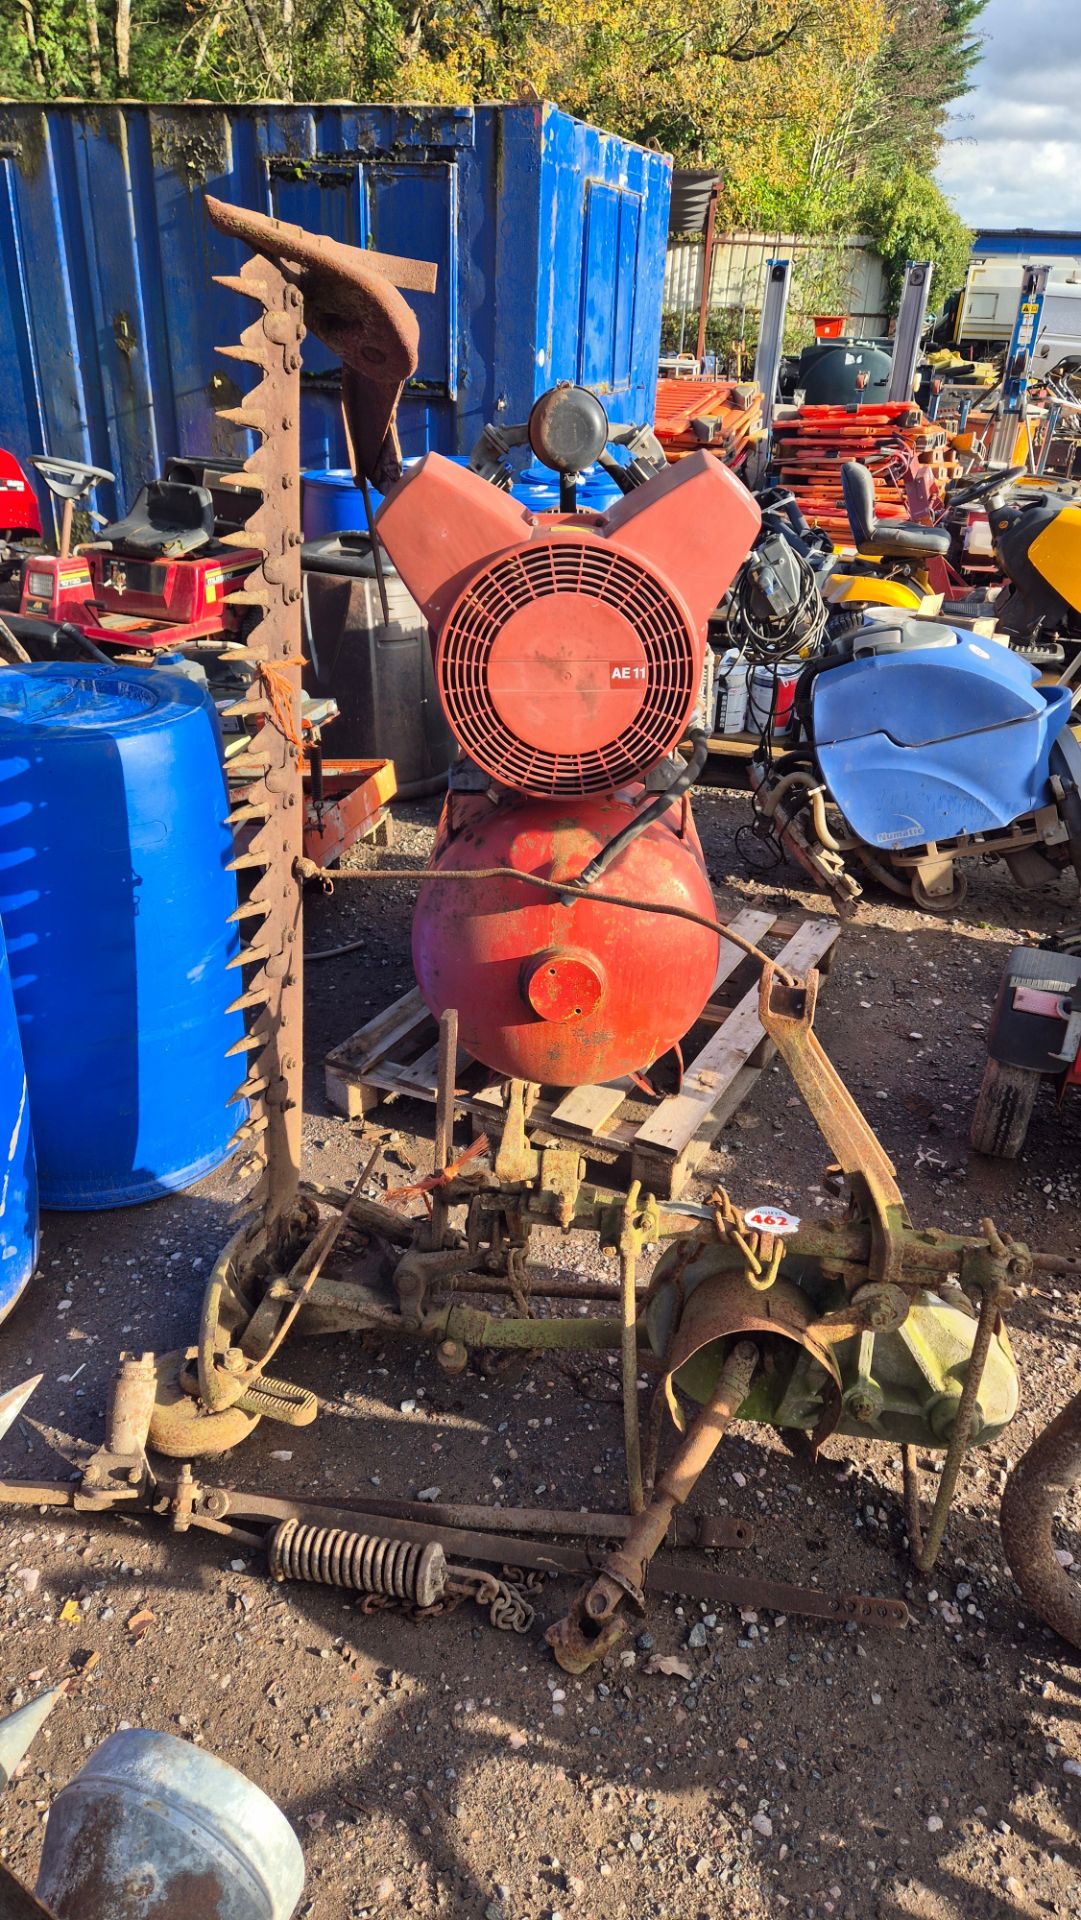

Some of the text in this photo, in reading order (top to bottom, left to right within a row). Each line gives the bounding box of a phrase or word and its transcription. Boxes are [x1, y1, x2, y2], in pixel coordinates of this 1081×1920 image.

[611, 667, 646, 679] AE 11
[878, 827, 923, 841] Numatic
[751, 1214, 788, 1226] 462
